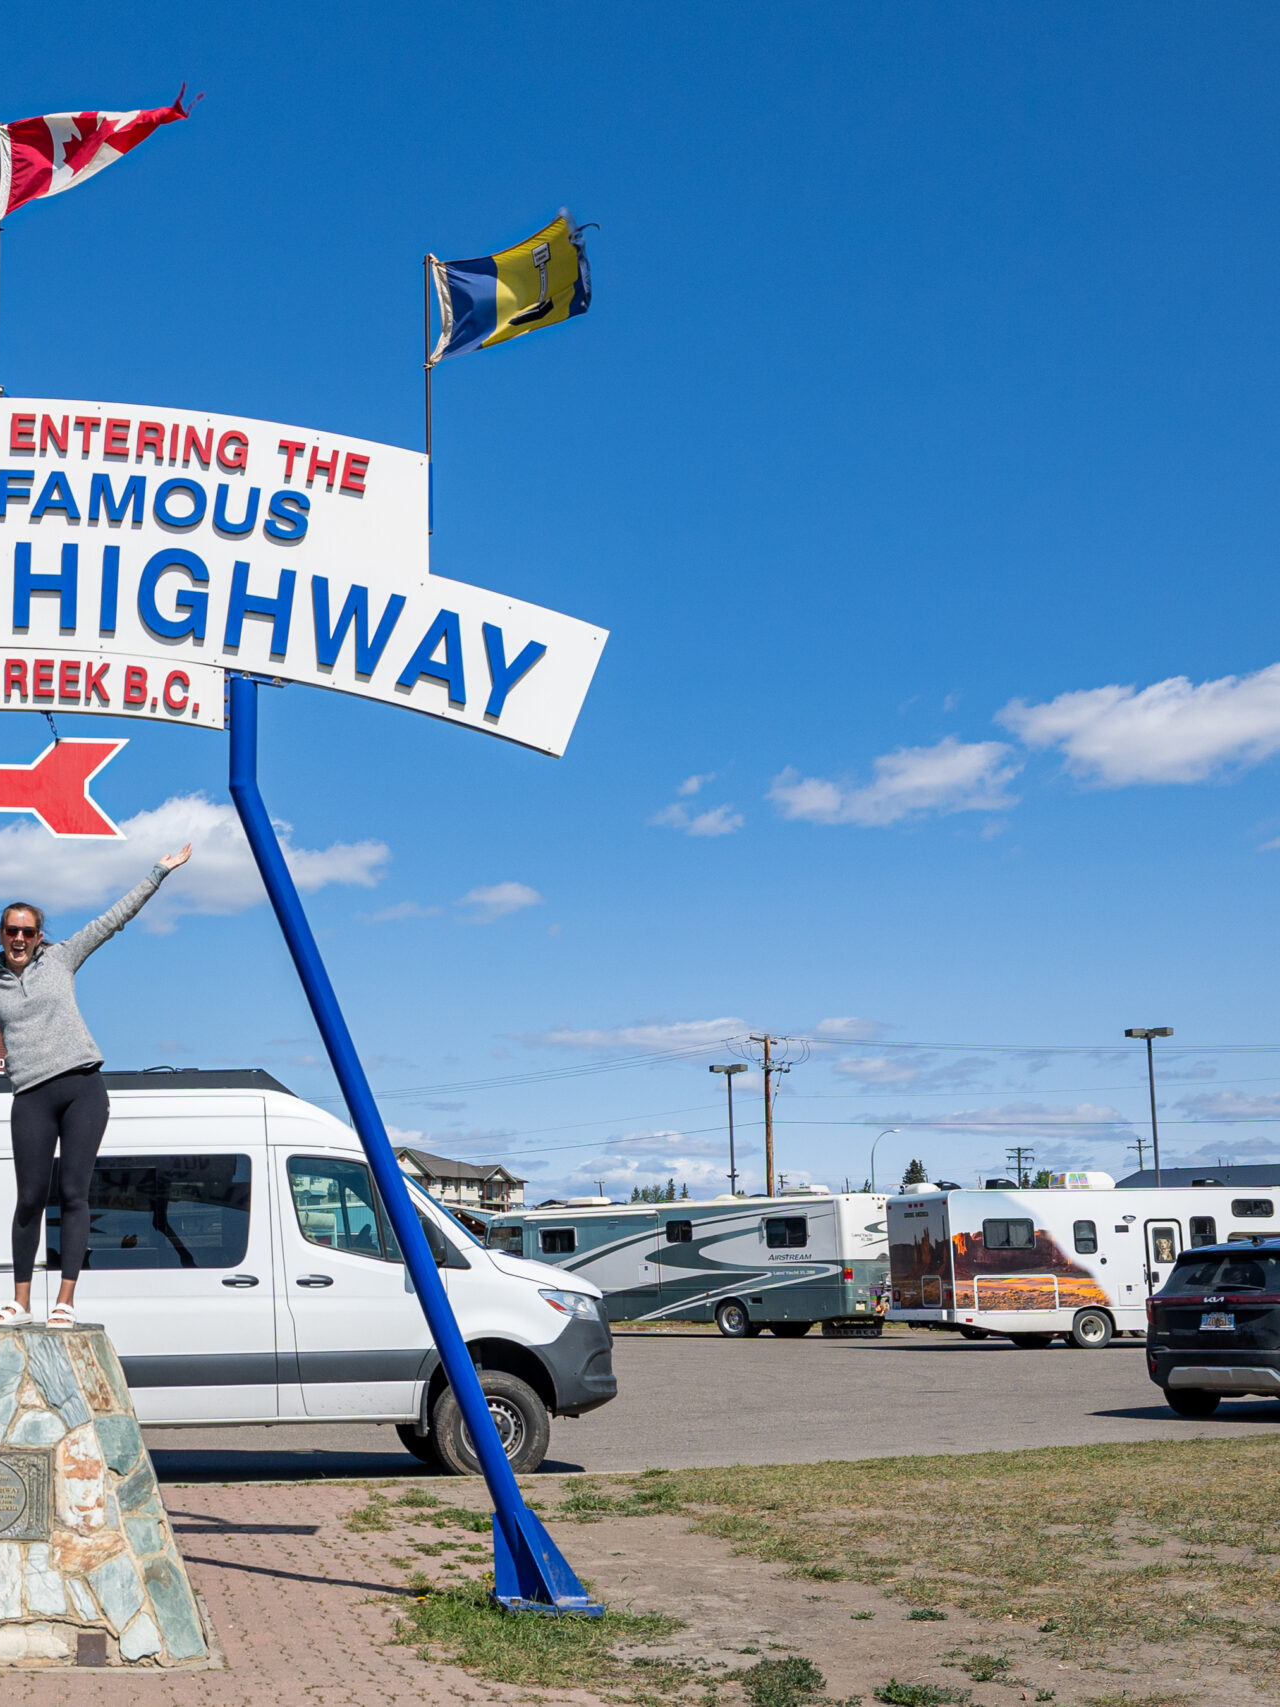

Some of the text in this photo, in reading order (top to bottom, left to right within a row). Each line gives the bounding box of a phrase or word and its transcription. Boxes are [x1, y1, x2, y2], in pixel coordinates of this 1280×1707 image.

[10, 412, 249, 469] ENTERING
[278, 439, 371, 492] THE
[13, 541, 548, 718] HIGHWAY
[124, 665, 200, 713] B.C.
[768, 1253, 812, 1261] AIRSTREAM
